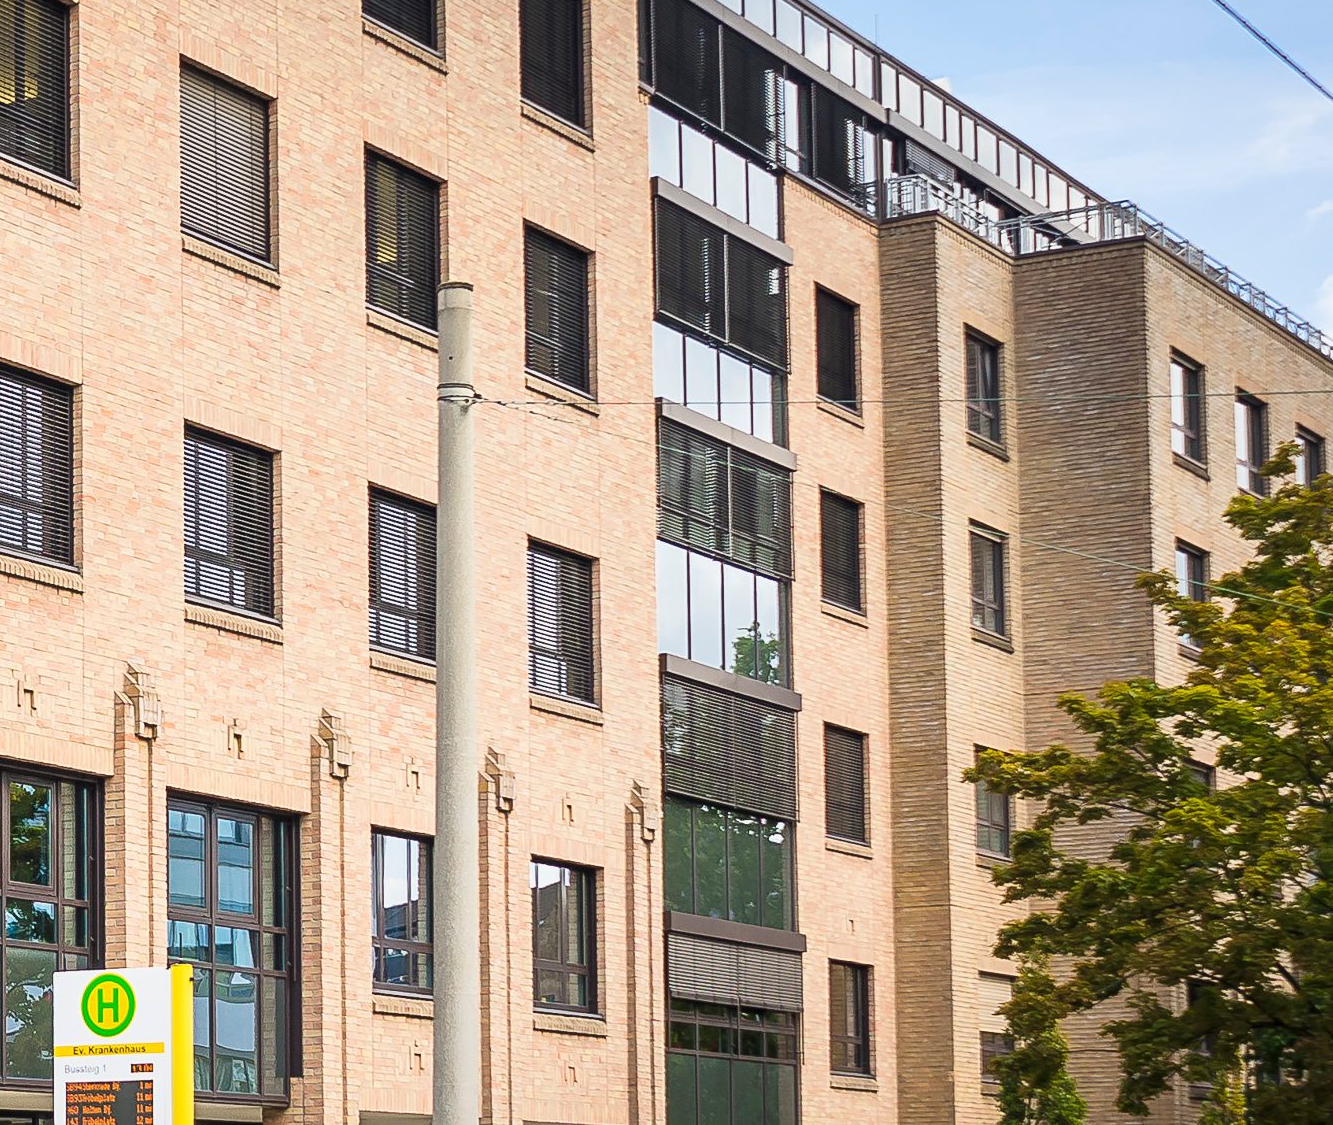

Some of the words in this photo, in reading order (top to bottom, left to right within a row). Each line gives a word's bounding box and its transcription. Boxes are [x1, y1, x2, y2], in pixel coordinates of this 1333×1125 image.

[73, 1046, 86, 1055] Ev.
[88, 1045, 146, 1055] Krankenhaus
[64, 1064, 100, 1075] Bussteig
